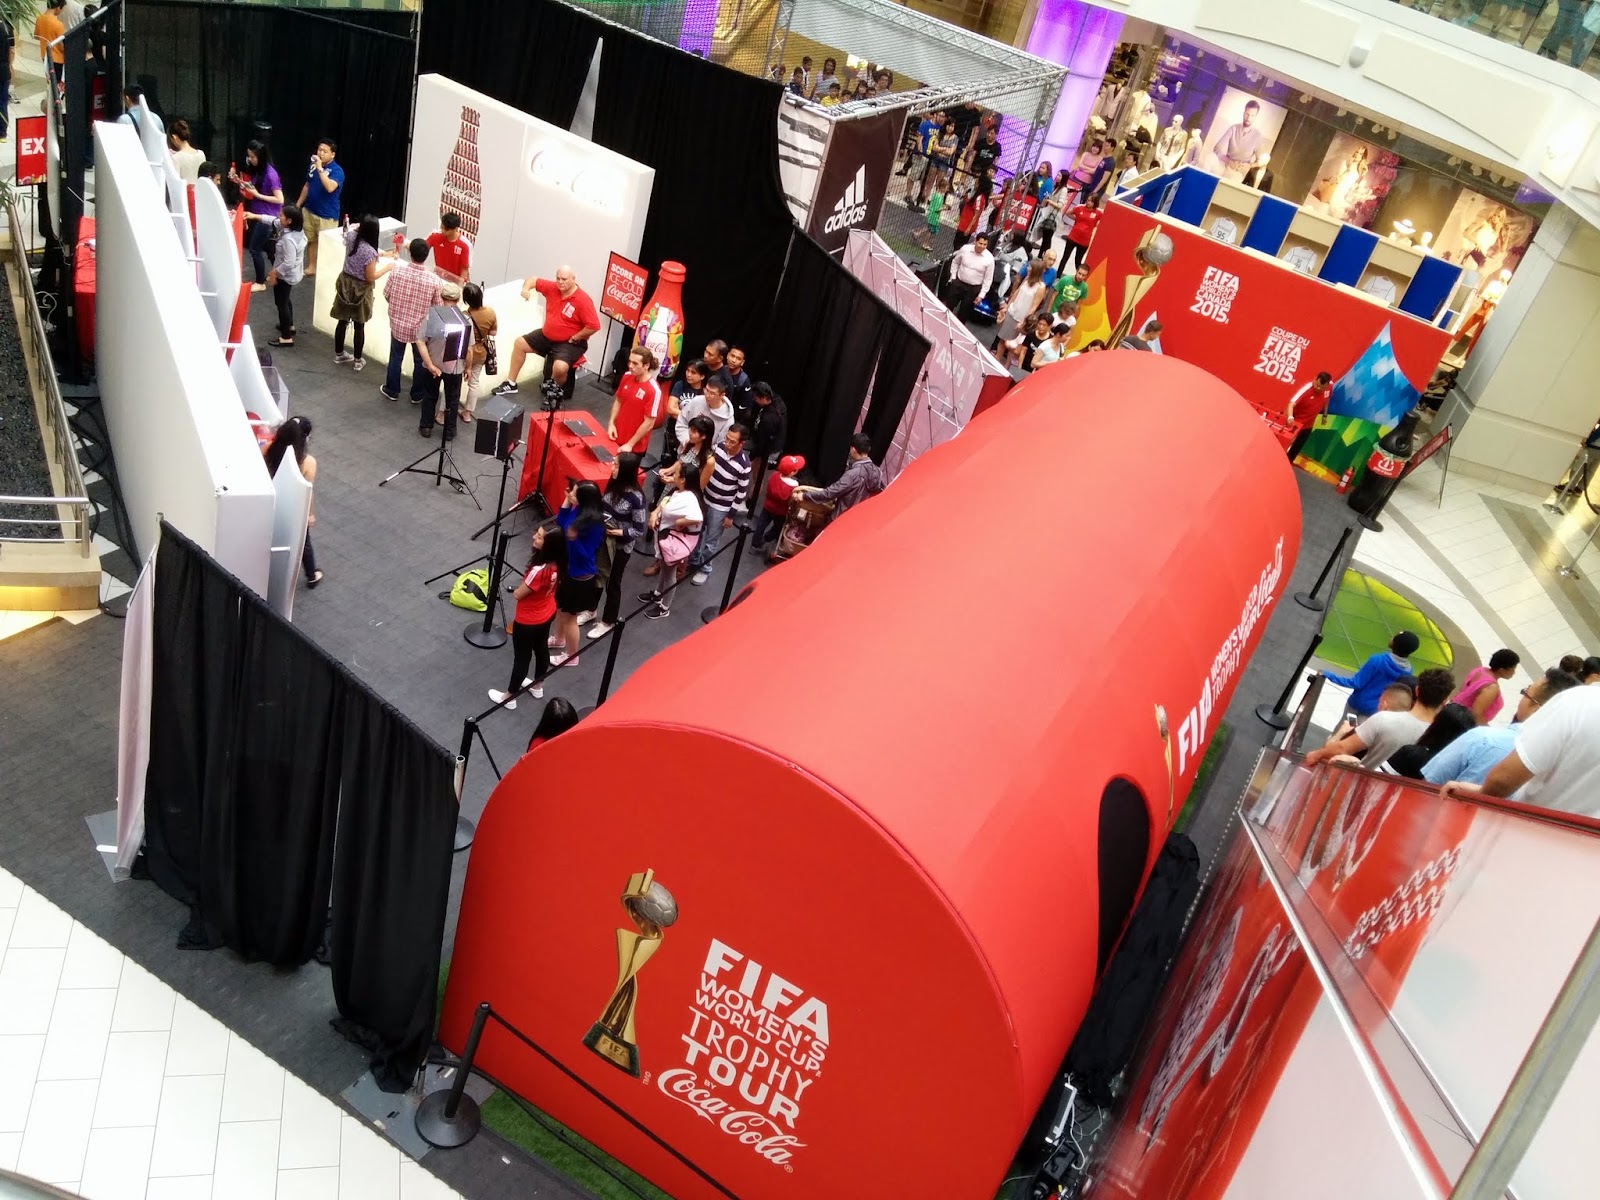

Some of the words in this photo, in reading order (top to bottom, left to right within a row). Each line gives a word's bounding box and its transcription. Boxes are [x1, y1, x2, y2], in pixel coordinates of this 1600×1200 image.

[21, 137, 45, 156] EX
[824, 204, 867, 234] adidas
[609, 272, 643, 297] ICE-COLD
[611, 263, 633, 280] SCORE
[634, 276, 645, 287] AN
[1202, 278, 1237, 296] WOMEN'S
[1203, 265, 1240, 291] FIFA
[606, 284, 643, 310] Coca-Cola
[1196, 289, 1232, 309] CANADA
[1200, 283, 1222, 296] WORLD
[1221, 292, 1235, 301] CUP
[1189, 296, 1229, 323] 2015
[1264, 335, 1302, 361] FIFA
[1271, 326, 1298, 341] COUPE
[1297, 336, 1310, 346] DU
[1253, 355, 1297, 383] 2015
[1261, 348, 1300, 369] CANADA
[703, 938, 829, 1046] FIFA
[695, 988, 772, 1045] WORLD
[775, 1039, 820, 1071] CUP
[701, 972, 828, 1061] WOMEN'S
[601, 1038, 627, 1057] FIFA
[688, 1005, 813, 1101] TROPHY
[681, 1033, 800, 1129] TOUR
[703, 1079, 717, 1090] BY
[657, 1068, 808, 1166] Coca-Cola
